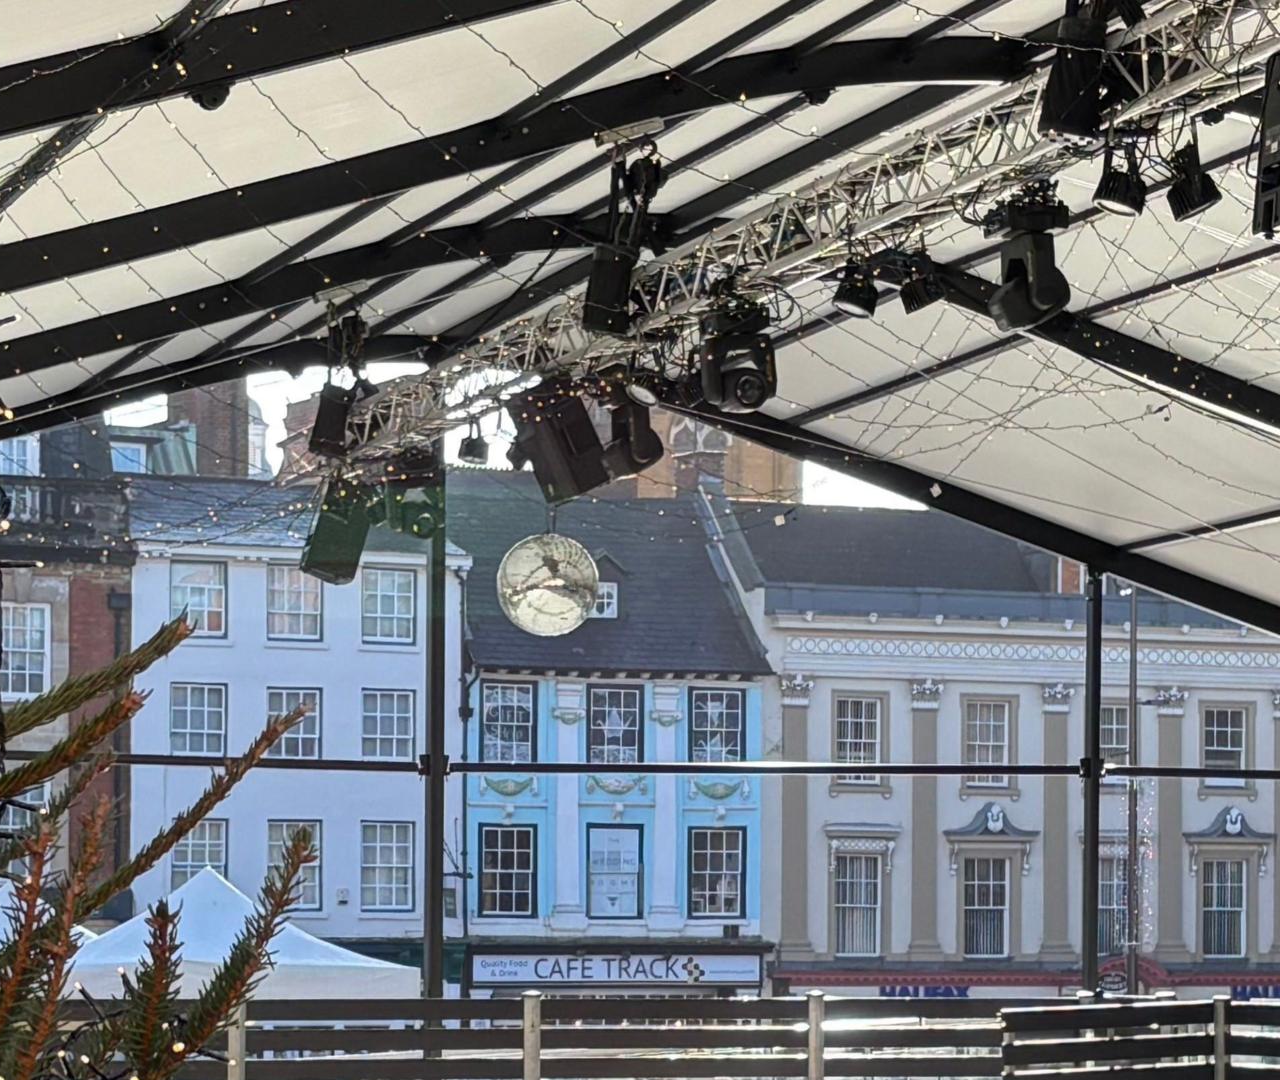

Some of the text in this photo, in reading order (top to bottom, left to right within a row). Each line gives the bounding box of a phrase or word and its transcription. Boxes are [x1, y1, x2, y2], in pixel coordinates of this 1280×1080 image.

[480, 959, 528, 969] Quality Food
[534, 957, 680, 979] CAFE TRACK
